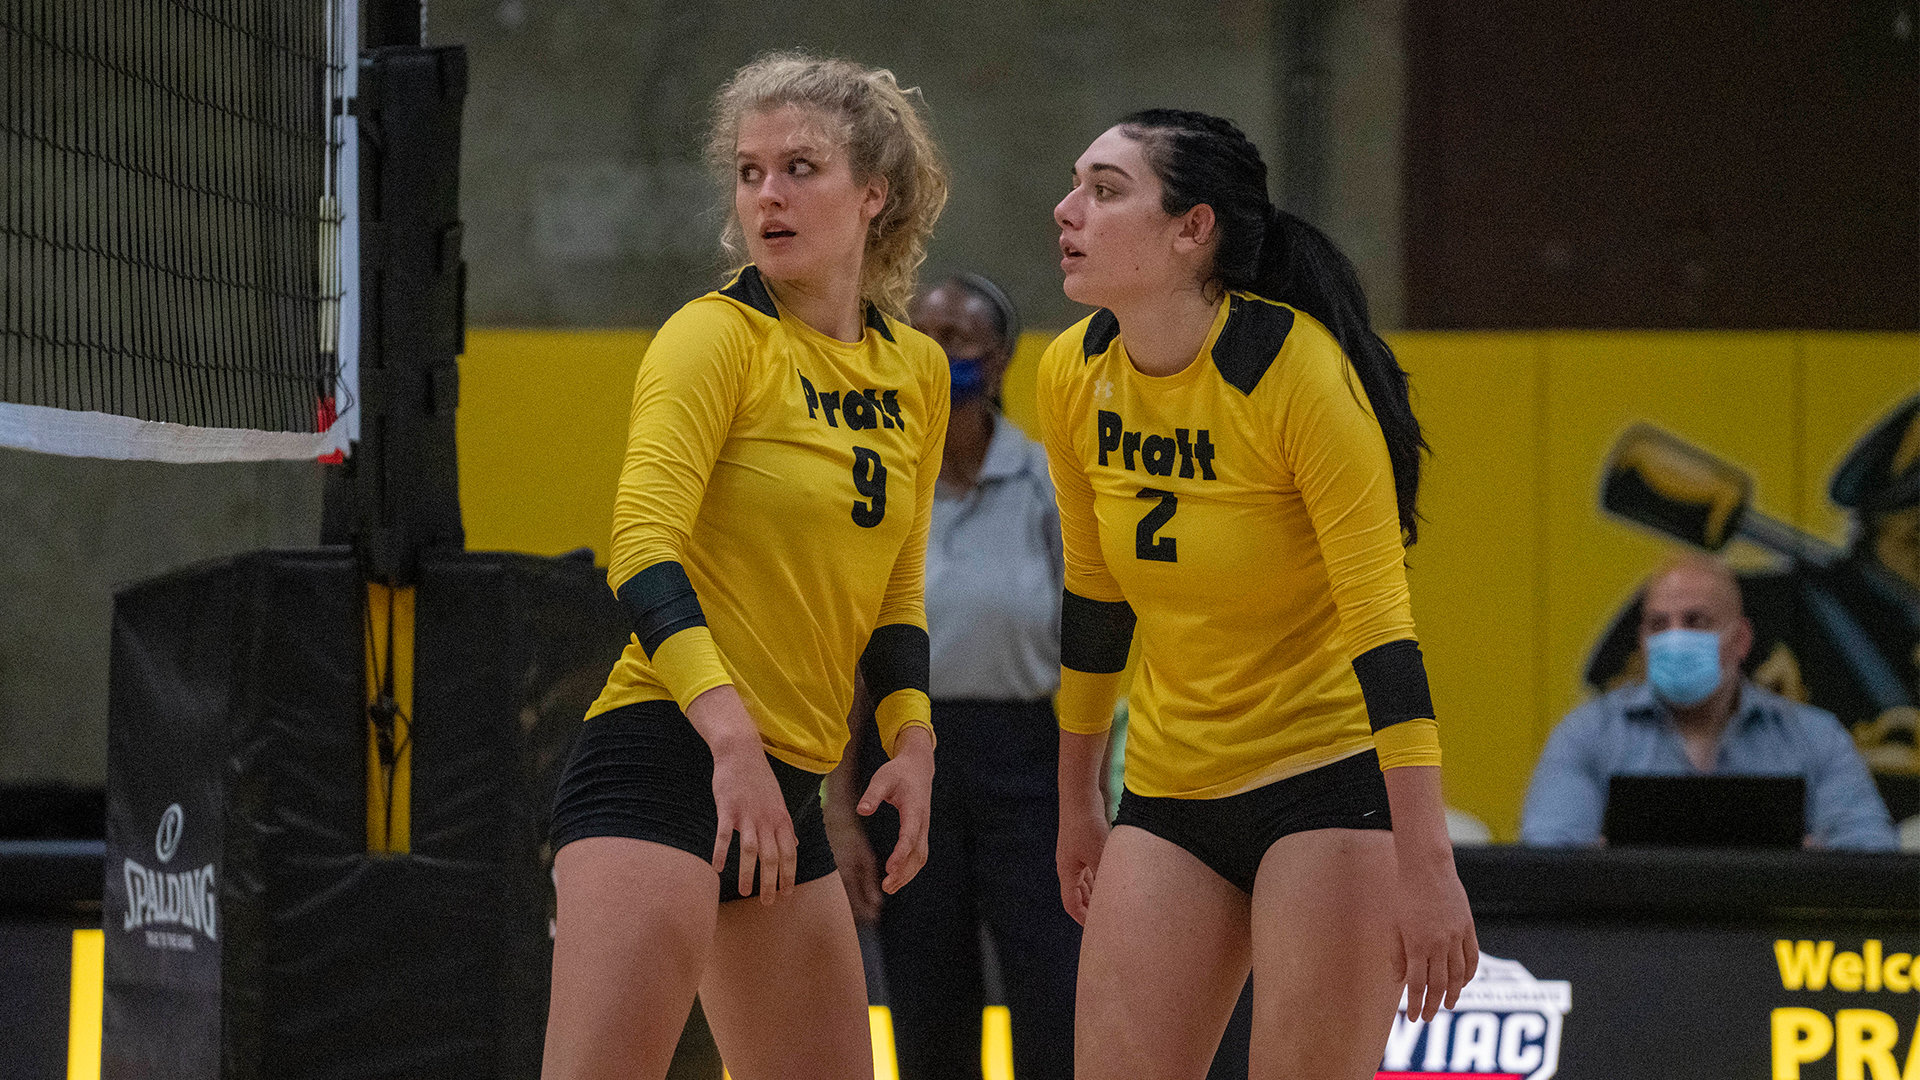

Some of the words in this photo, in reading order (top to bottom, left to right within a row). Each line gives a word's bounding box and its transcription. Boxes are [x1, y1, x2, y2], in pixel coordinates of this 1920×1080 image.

[796, 368, 905, 432] Pratt
[1097, 409, 1217, 481] Pratt
[851, 445, 887, 528] 9
[1135, 487, 1178, 563] 2
[123, 858, 217, 941] SPALDING
[1769, 1007, 1920, 1080] PR
